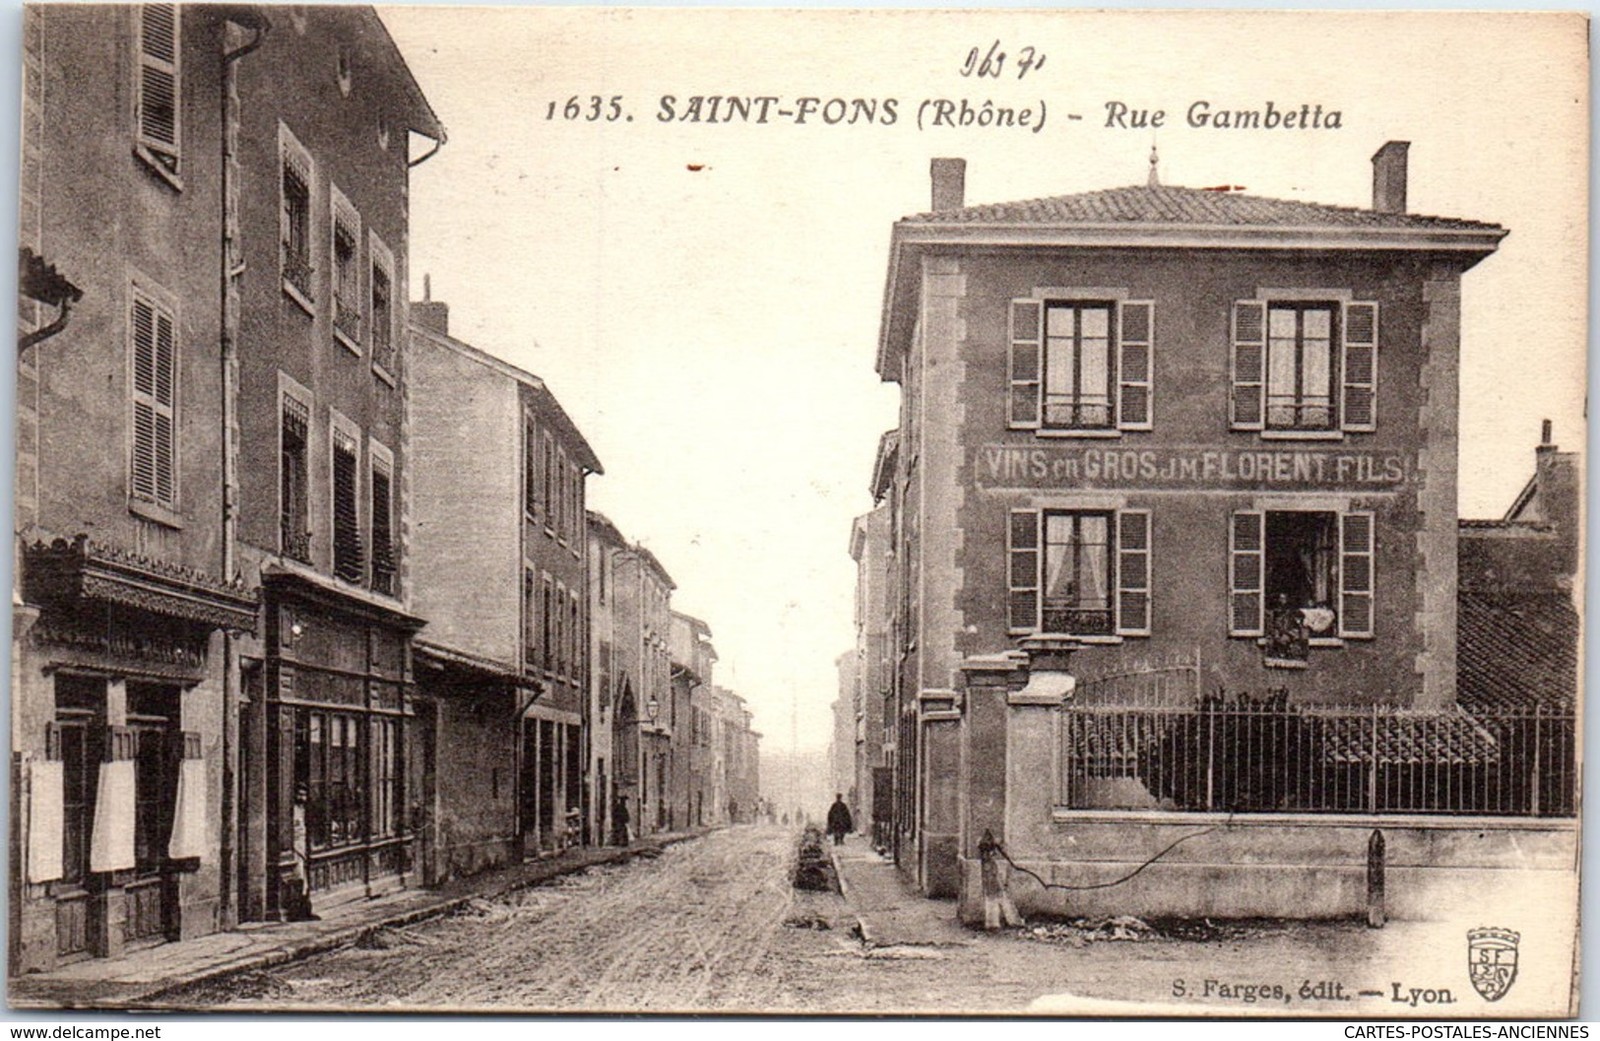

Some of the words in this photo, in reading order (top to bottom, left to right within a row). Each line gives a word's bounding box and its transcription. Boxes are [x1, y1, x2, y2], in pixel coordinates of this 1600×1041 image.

[986, 449, 1048, 479] VINS
[1052, 457, 1080, 479] en
[1084, 449, 1158, 481] GROS
[1336, 455, 1402, 482] FILS
